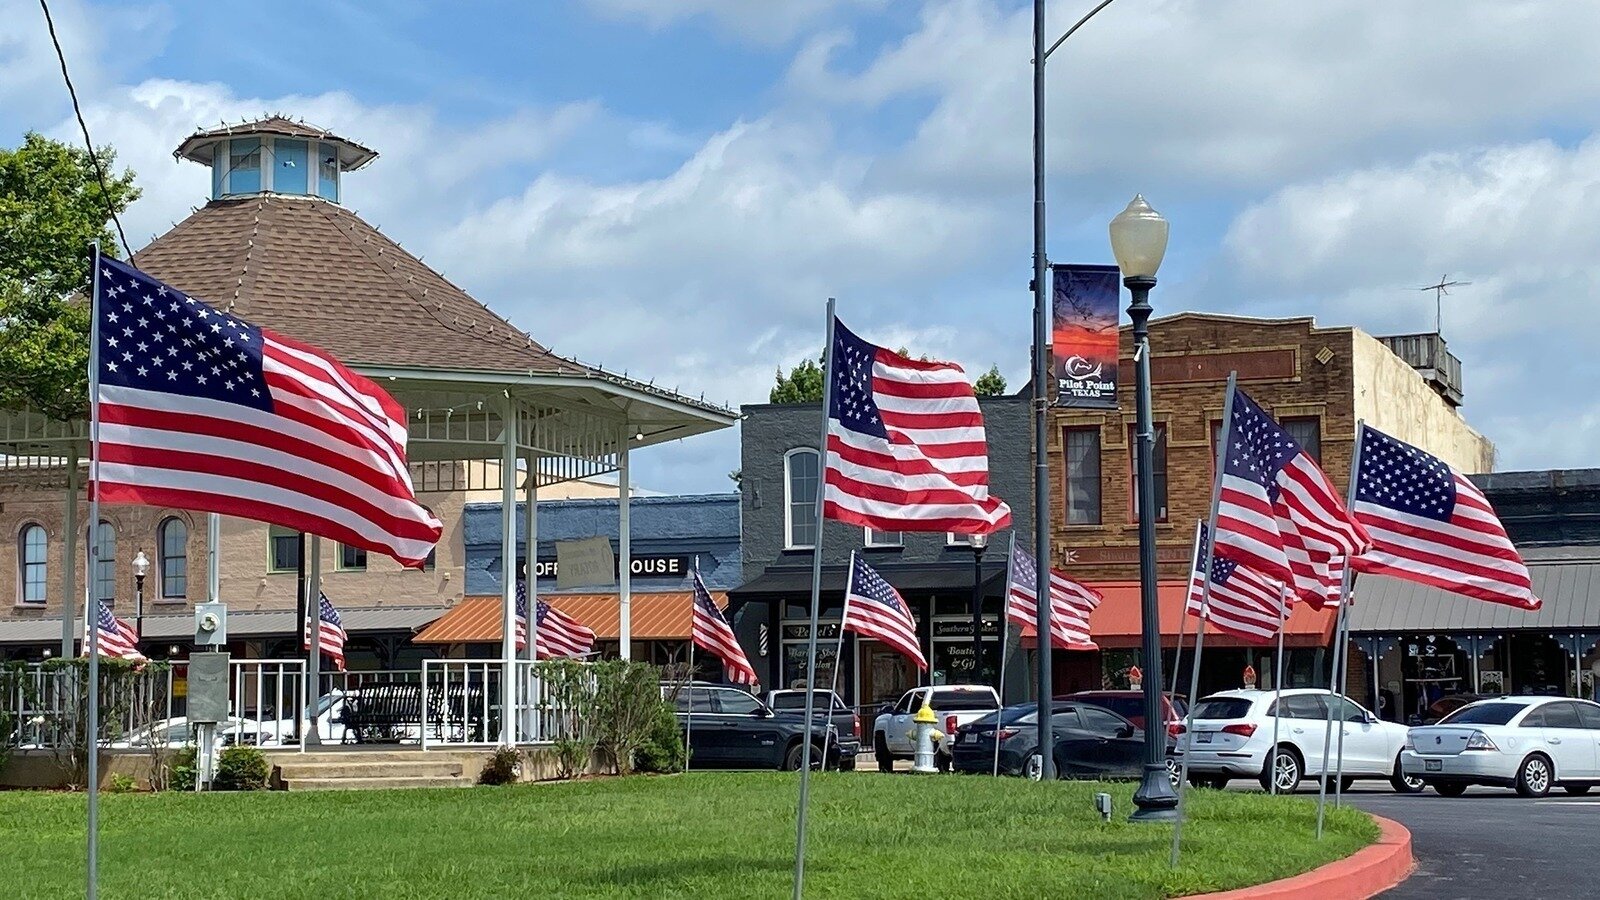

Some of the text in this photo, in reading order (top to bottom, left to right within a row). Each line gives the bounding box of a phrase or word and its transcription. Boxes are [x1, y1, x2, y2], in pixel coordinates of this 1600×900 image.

[1059, 379, 1115, 390] Pilot Point
[1071, 389, 1101, 398] TEXAS
[619, 558, 679, 574] OUSE
[951, 658, 961, 668] &
